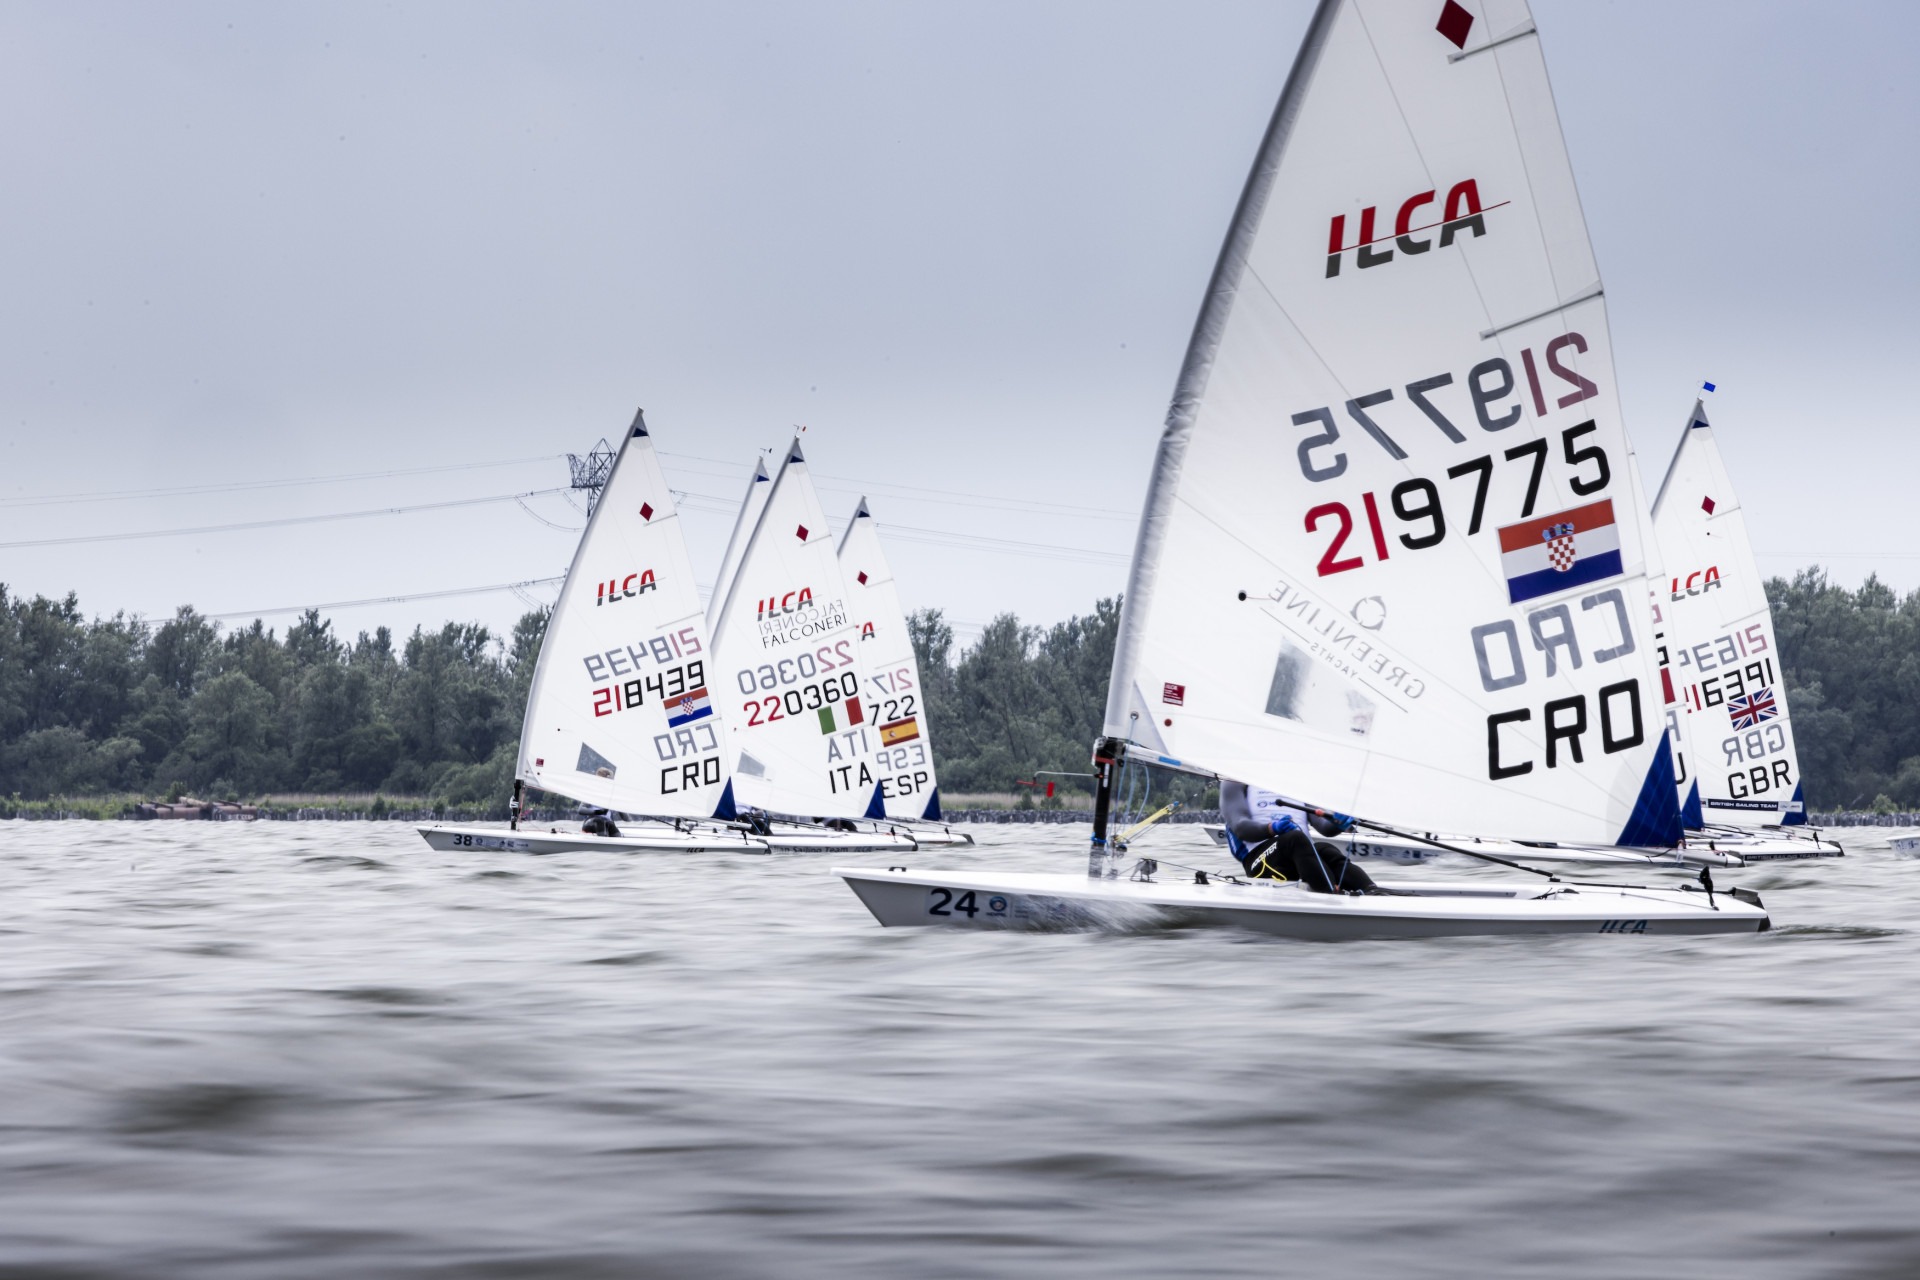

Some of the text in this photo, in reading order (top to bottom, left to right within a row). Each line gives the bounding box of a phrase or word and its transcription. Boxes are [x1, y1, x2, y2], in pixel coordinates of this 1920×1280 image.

[1325, 178, 1486, 279] ILCA
[1304, 418, 1611, 577] 219775
[597, 568, 657, 607] ILCA
[757, 586, 814, 622] ILCA
[762, 612, 848, 649] FALCONERI
[592, 659, 705, 718] 218439
[743, 671, 858, 727] 220360
[1487, 677, 1644, 781] CRO
[660, 756, 721, 795] CRO
[829, 761, 873, 794] ITA
[879, 771, 929, 799] ESP
[1727, 759, 1792, 800] GBR
[453, 833, 473, 847] 38
[929, 887, 980, 918] 24
